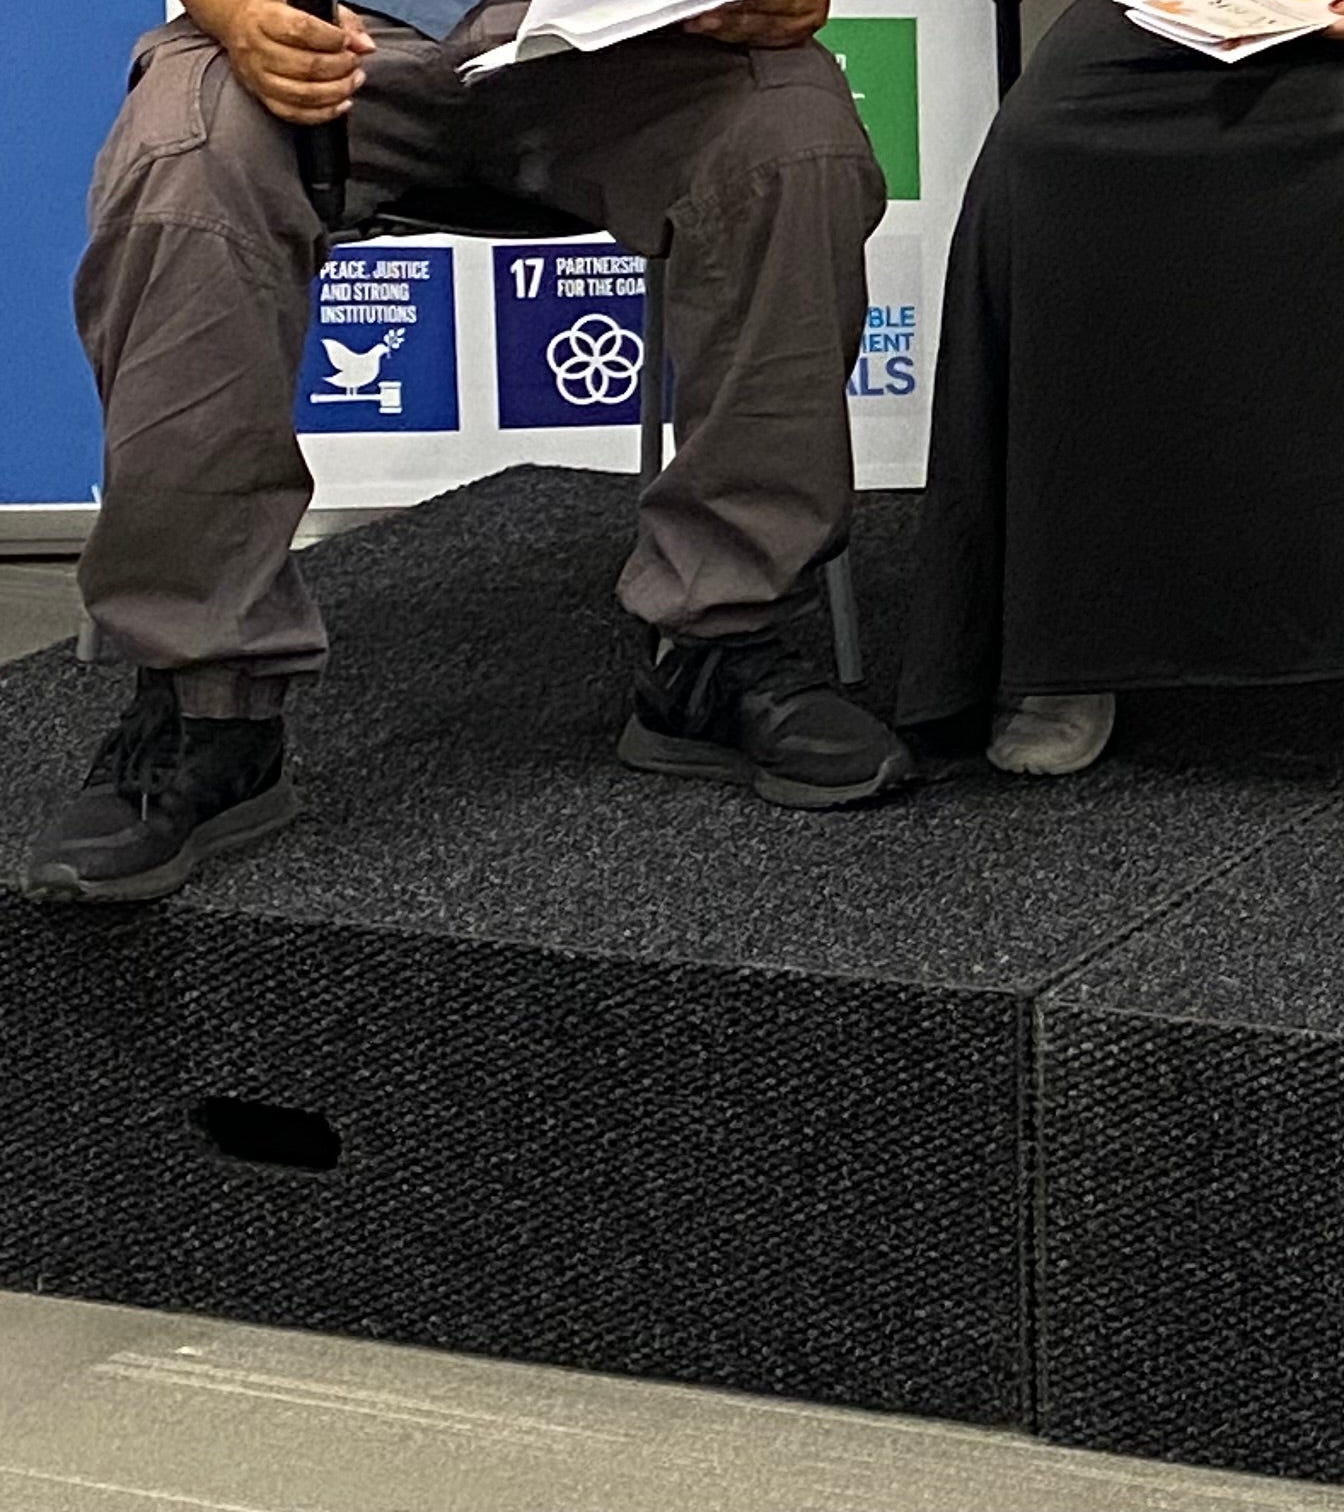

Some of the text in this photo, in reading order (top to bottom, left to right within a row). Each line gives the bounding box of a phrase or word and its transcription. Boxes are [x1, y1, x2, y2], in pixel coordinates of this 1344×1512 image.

[372, 261, 431, 279] JUSTICE
[556, 256, 647, 275] PARTNERSHI
[510, 257, 545, 299] 17
[557, 277, 647, 298] FOR THE GOA
[320, 282, 410, 302] AND STRONG
[320, 305, 417, 324] INSTITUTIONS
[863, 333, 915, 354] ENT
